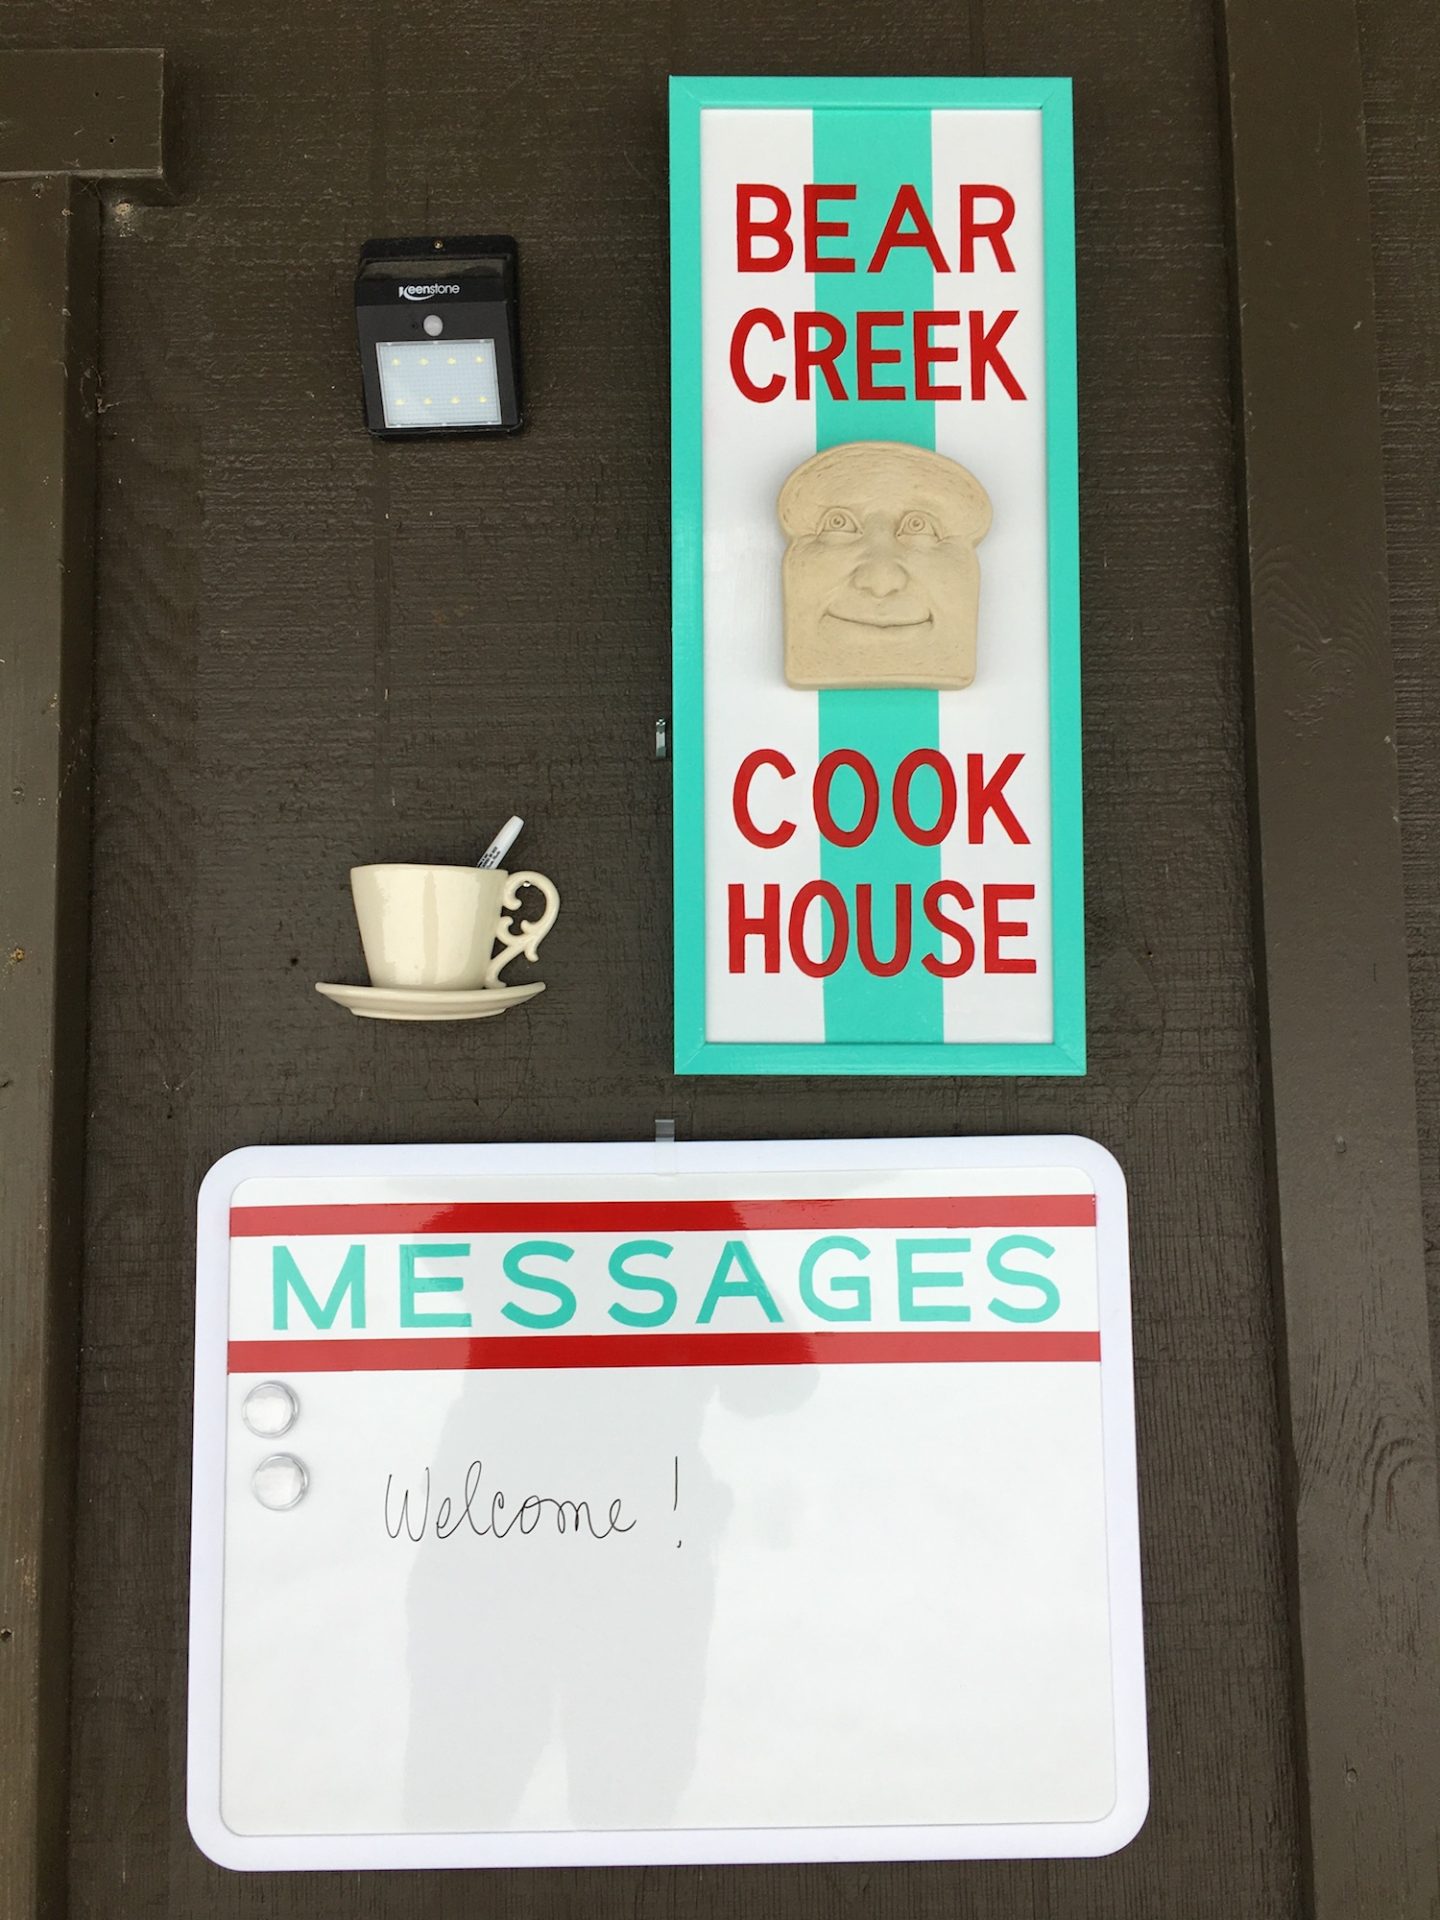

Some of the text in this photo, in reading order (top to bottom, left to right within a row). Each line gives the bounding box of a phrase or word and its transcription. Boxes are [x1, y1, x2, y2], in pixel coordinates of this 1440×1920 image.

[735, 183, 1016, 273] BEAR
[398, 283, 460, 301] Keenstone
[729, 307, 1028, 404] CREEK
[732, 748, 1032, 850] COOK
[727, 879, 1038, 979] HOUSE
[272, 1234, 1061, 1332] MESSAGES
